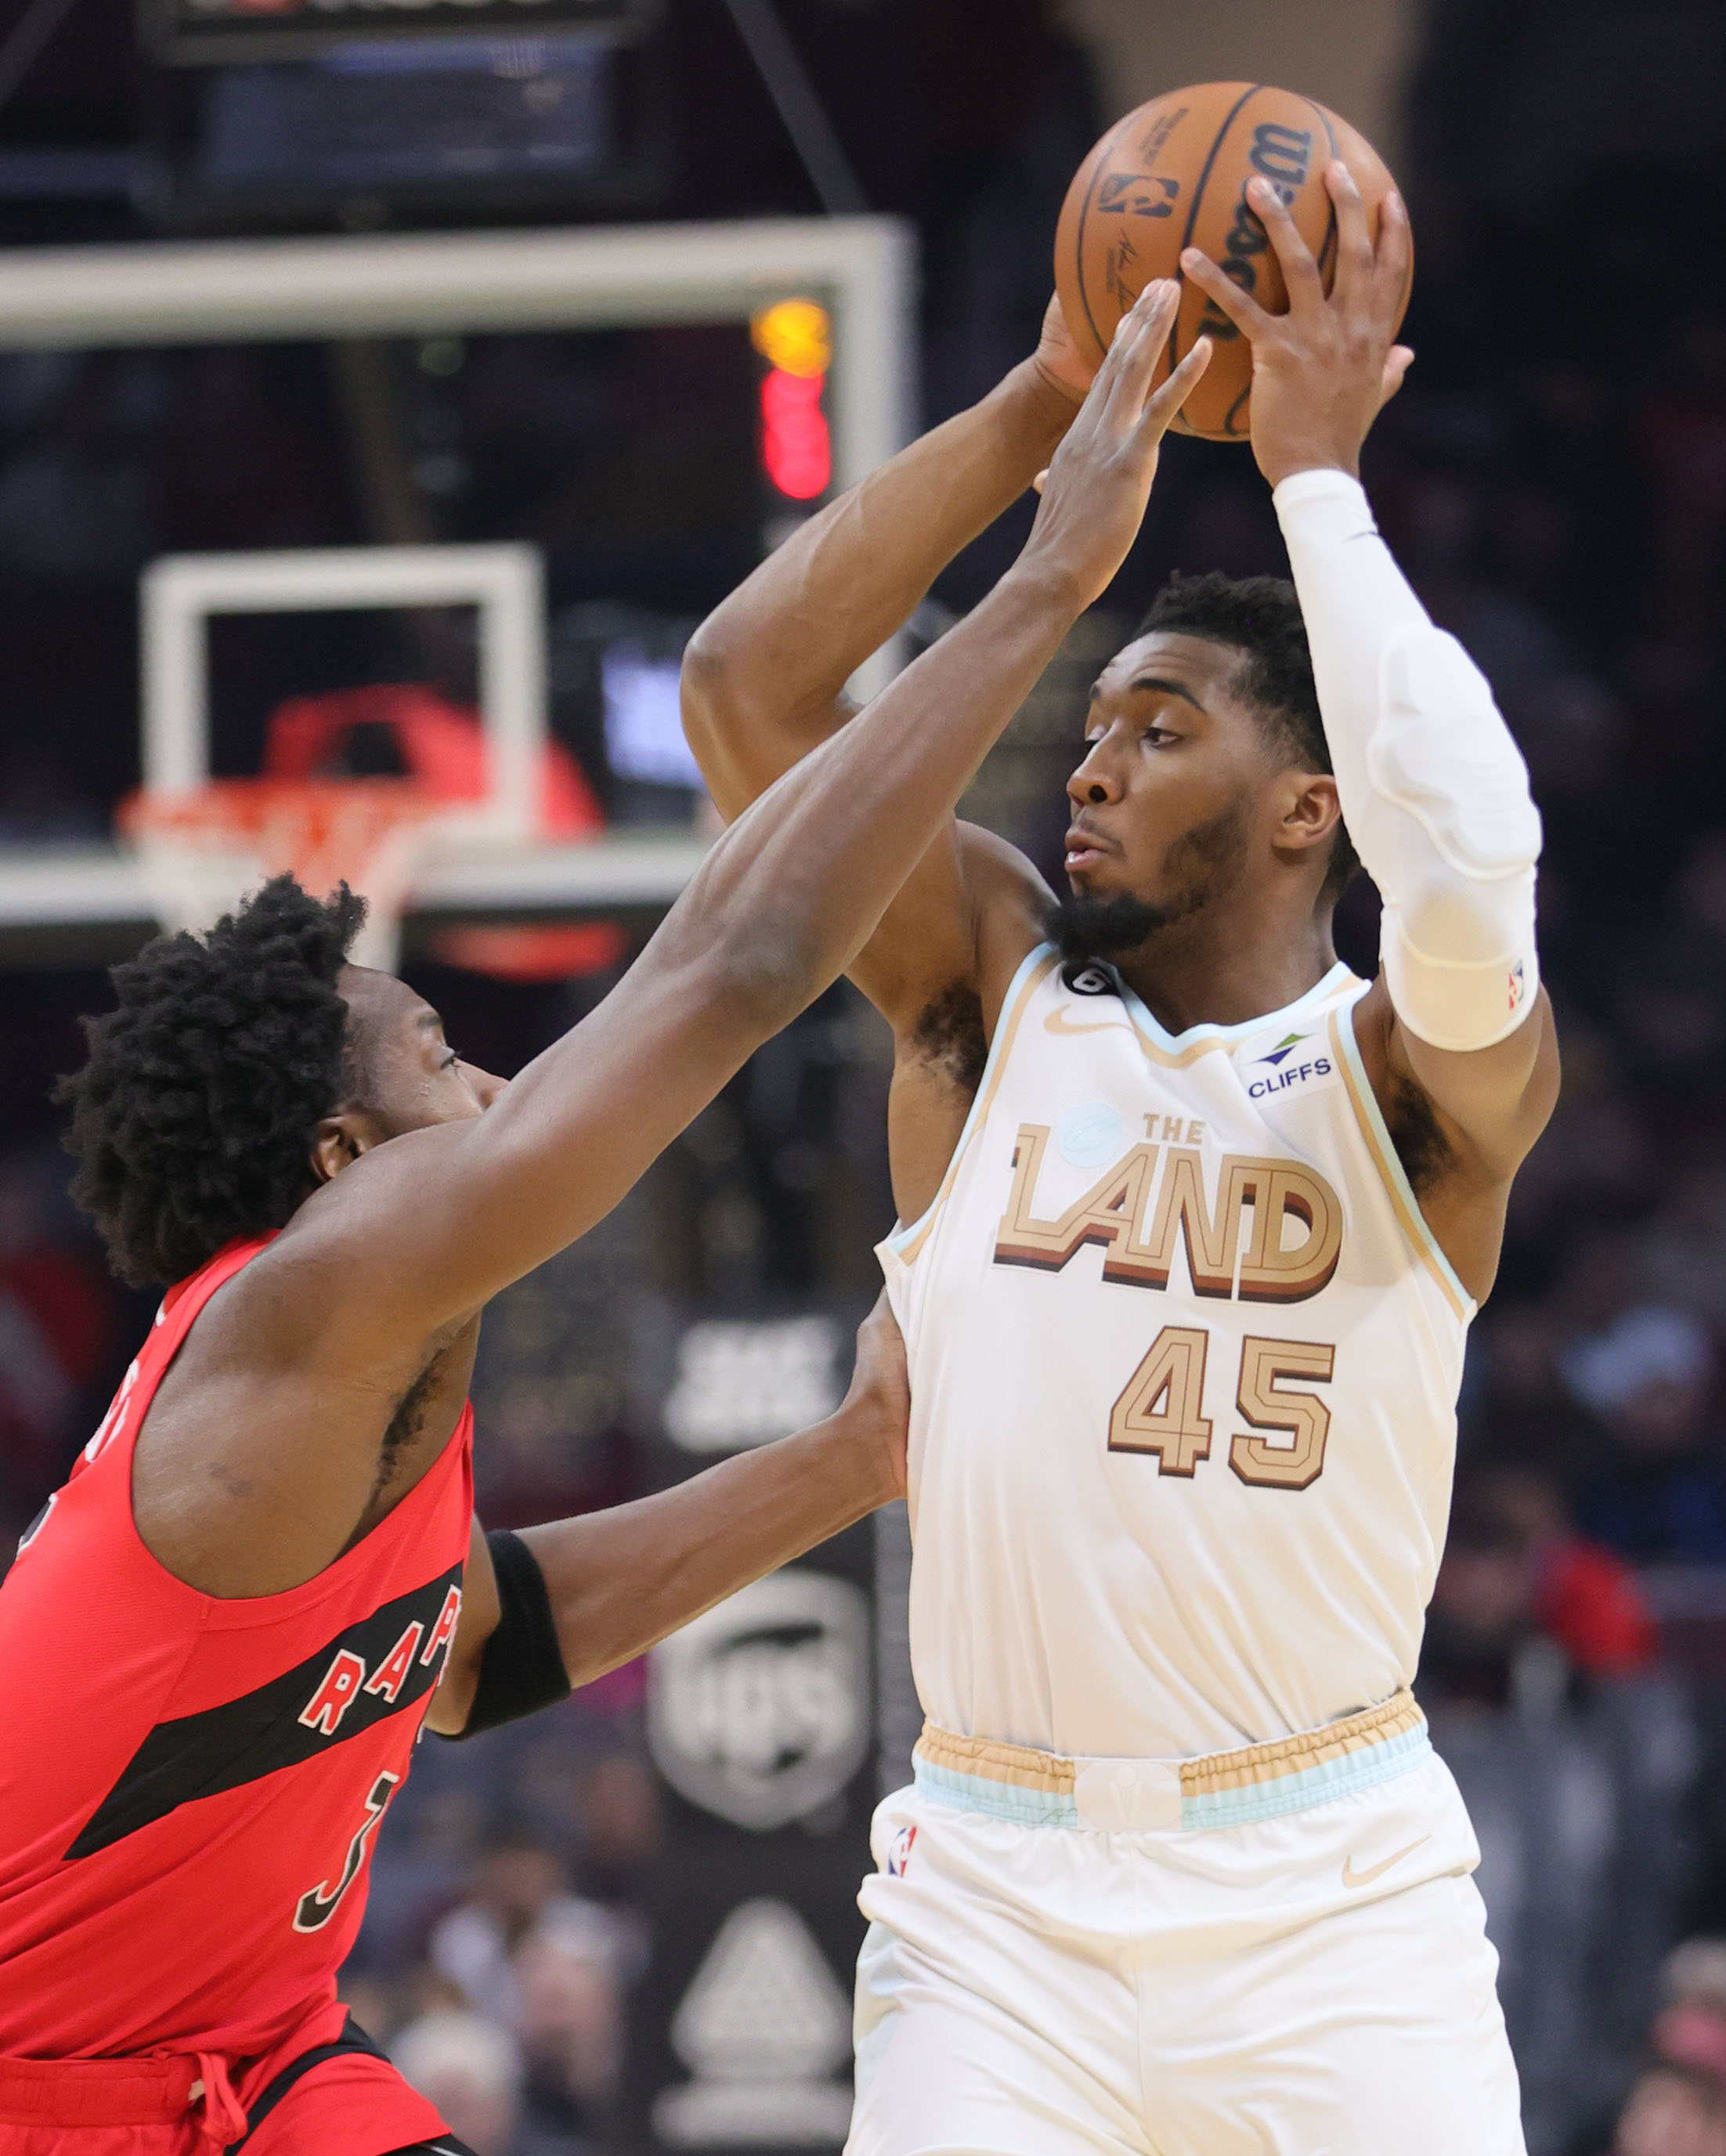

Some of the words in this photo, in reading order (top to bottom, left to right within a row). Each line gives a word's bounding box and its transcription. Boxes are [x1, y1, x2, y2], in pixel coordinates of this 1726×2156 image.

[1143, 1112, 1207, 1145] THE
[1248, 1057, 1331, 1099] CLIFFS
[993, 1122, 1343, 1304] LAND
[1107, 1325, 1336, 1491] 45
[297, 1584, 462, 1736] RAP
